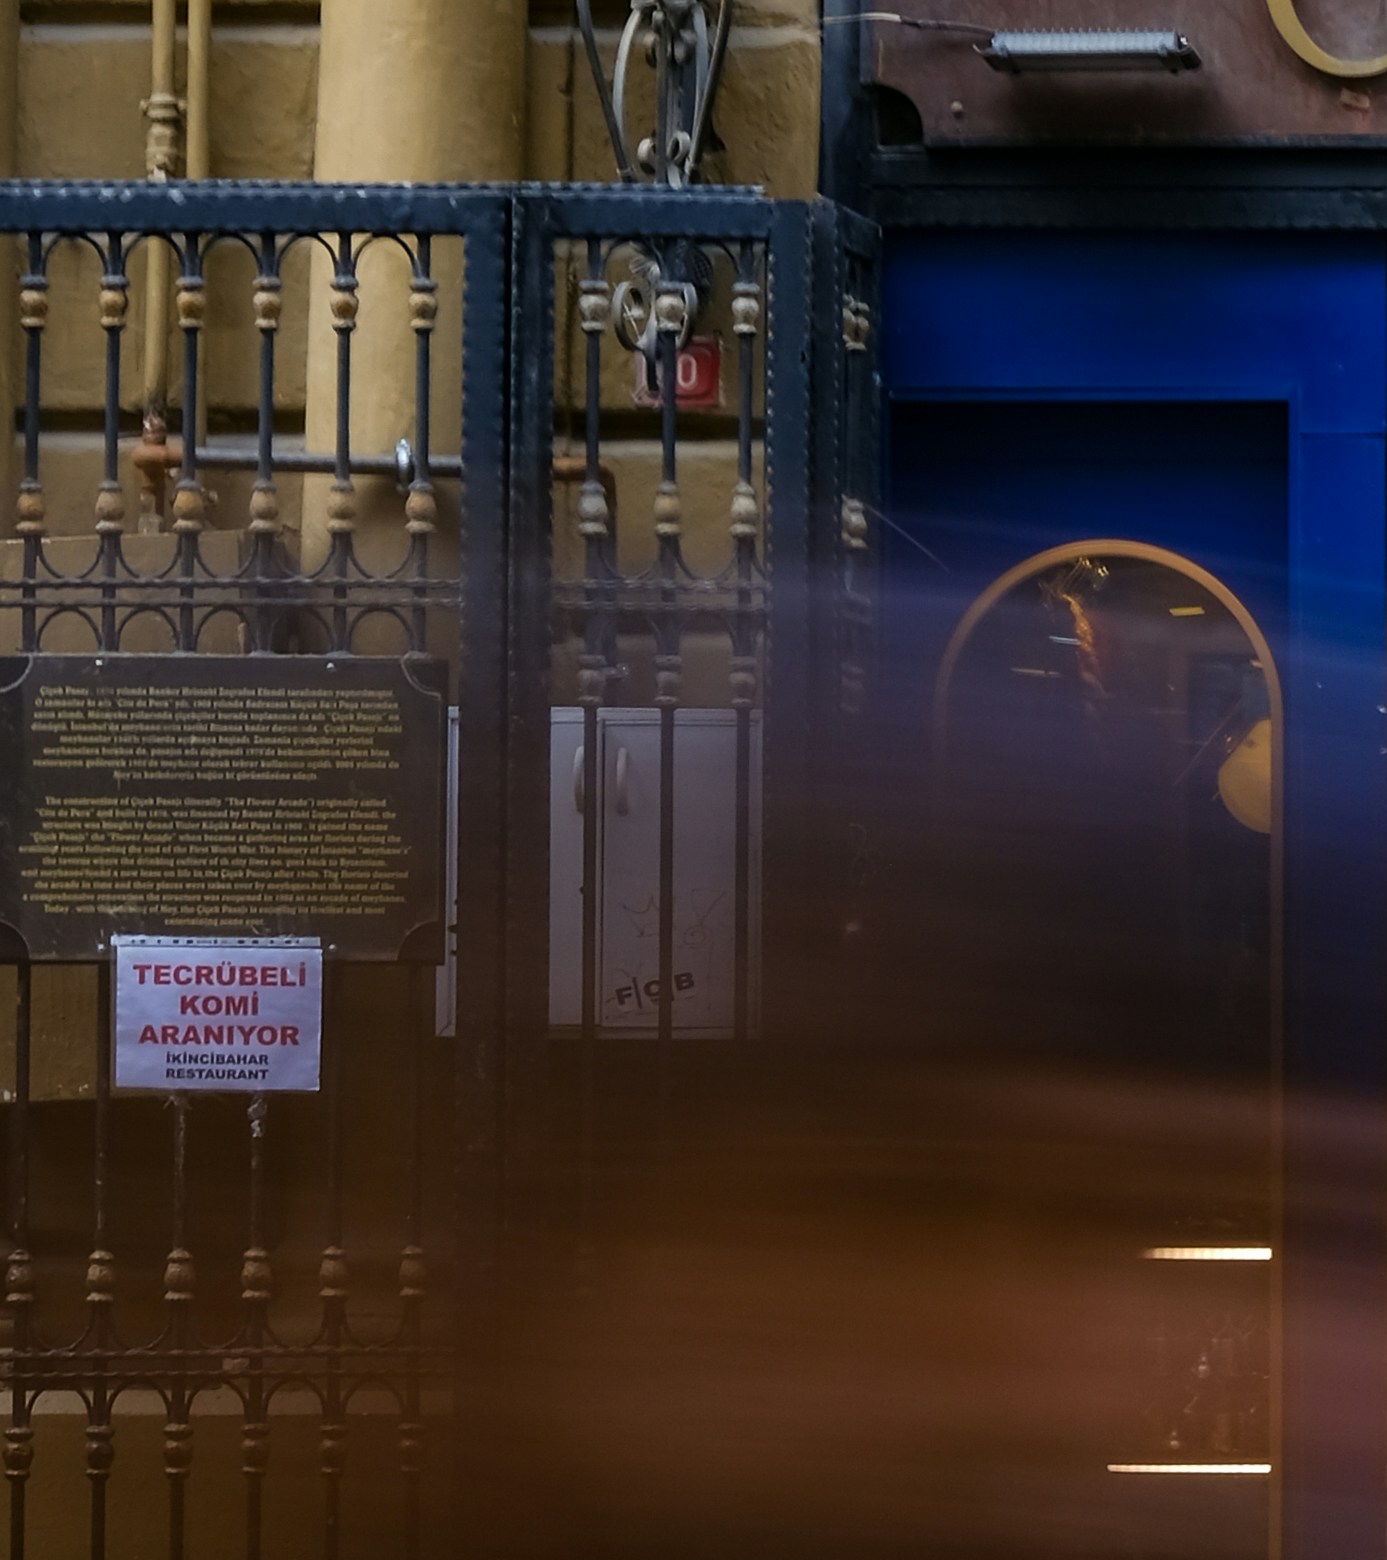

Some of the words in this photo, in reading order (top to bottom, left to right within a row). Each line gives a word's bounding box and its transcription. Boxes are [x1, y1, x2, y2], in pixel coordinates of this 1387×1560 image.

[132, 960, 307, 987] TECRÜBELİ
[180, 990, 259, 1016] KOMİ
[138, 1024, 300, 1046] ARANIYOR
[166, 1051, 269, 1066] İKİNCİBAHAR
[165, 1067, 269, 1081] RESTAURANT
